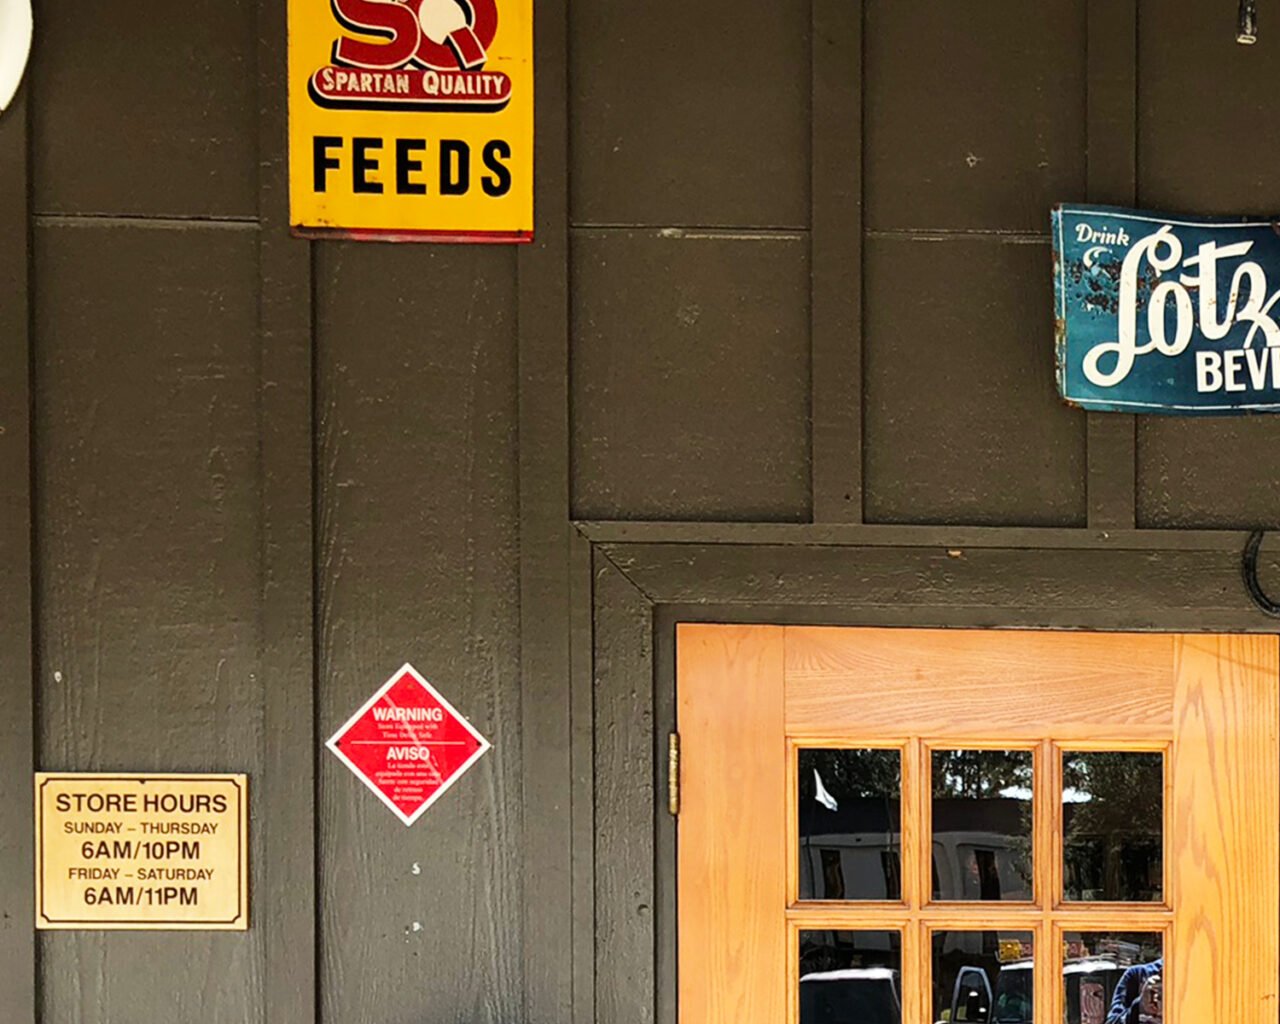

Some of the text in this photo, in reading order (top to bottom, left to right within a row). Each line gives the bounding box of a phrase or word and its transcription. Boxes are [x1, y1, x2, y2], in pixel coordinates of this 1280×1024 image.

[331, 0, 499, 71] SQ
[322, 67, 504, 96] SPARTAN QUALITY
[312, 135, 512, 198] FEEDS
[1075, 223, 1130, 247] Drink
[372, 707, 443, 722] WARNING
[386, 746, 431, 761] AVISO
[56, 793, 228, 813] STORE HOURS
[63, 821, 123, 834] SUNDAY
[140, 822, 219, 834] THURSDAY
[81, 841, 200, 860] 6AM/10PM
[68, 867, 120, 880] FRIDAY
[137, 868, 215, 880] SATURDAY
[84, 887, 198, 906] 6AM/11PM
